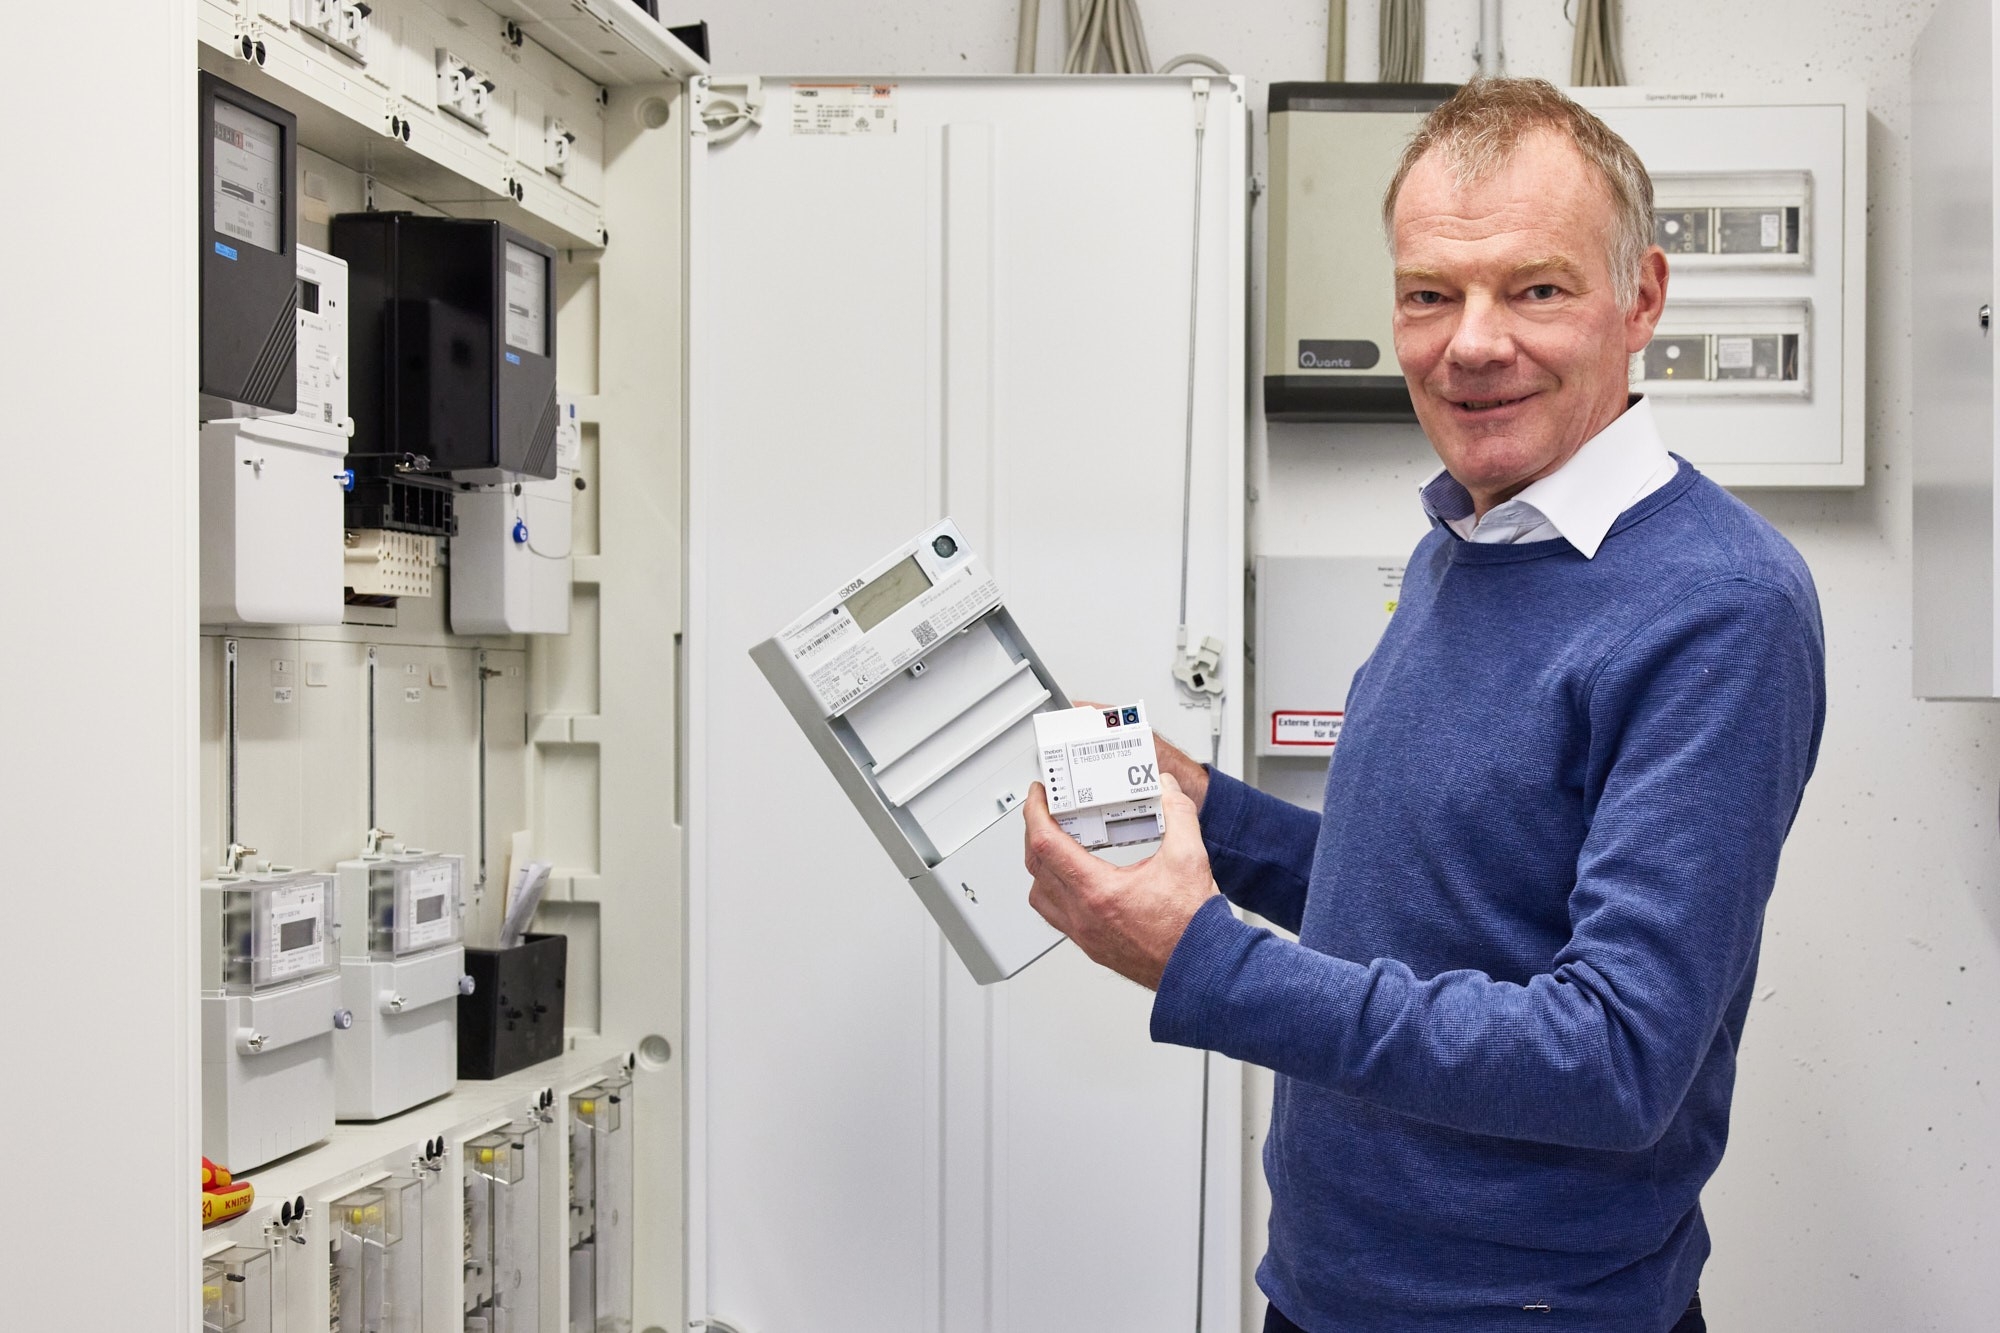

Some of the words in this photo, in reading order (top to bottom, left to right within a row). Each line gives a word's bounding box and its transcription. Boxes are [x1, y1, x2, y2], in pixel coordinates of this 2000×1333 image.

[1300, 351, 1351, 367] Quante
[838, 578, 865, 599] ISKRA
[1278, 718, 1310, 726] Externe
[1314, 730, 1326, 738] für
[1080, 754, 1101, 763] THE03
[1101, 752, 1116, 760] 0001
[1127, 763, 1156, 785] CX
[1130, 786, 1150, 794] CONEXA
[225, 1195, 251, 1210] KNIPEX
